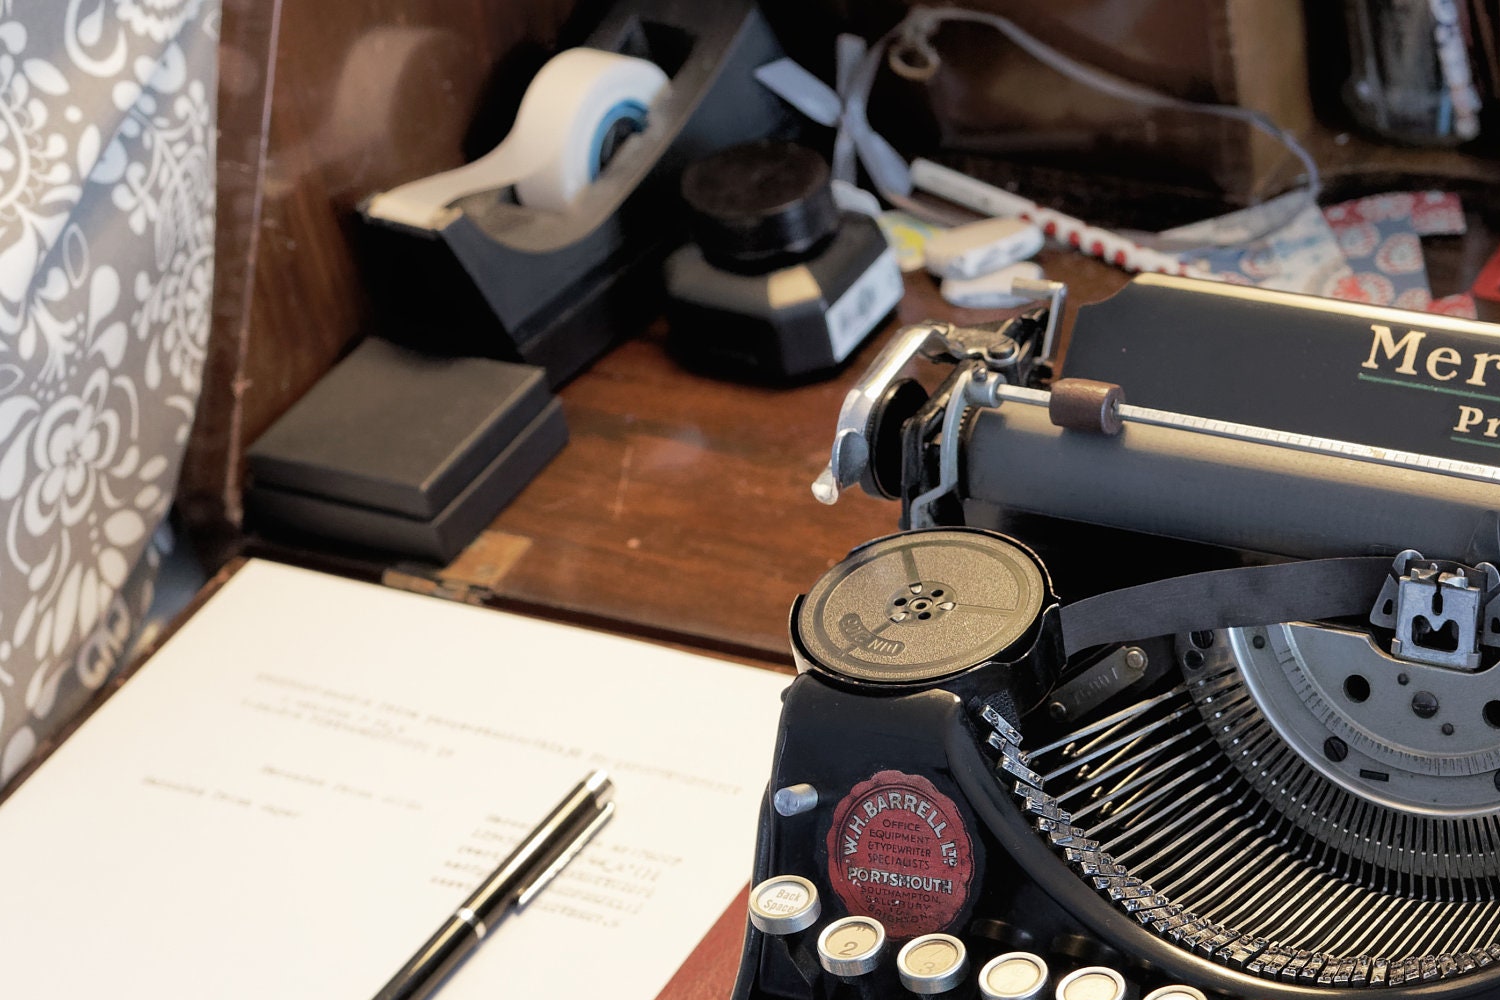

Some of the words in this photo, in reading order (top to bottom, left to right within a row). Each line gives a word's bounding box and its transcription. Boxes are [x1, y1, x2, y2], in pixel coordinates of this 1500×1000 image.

[882, 818, 921, 832] OFFICE
[869, 829, 931, 844] EQUIPMENT
[867, 853, 930, 870] SPECIALISTS
[848, 867, 953, 894] PORTSMOUTH
[776, 888, 801, 902] Back
[839, 941, 858, 956] 2
